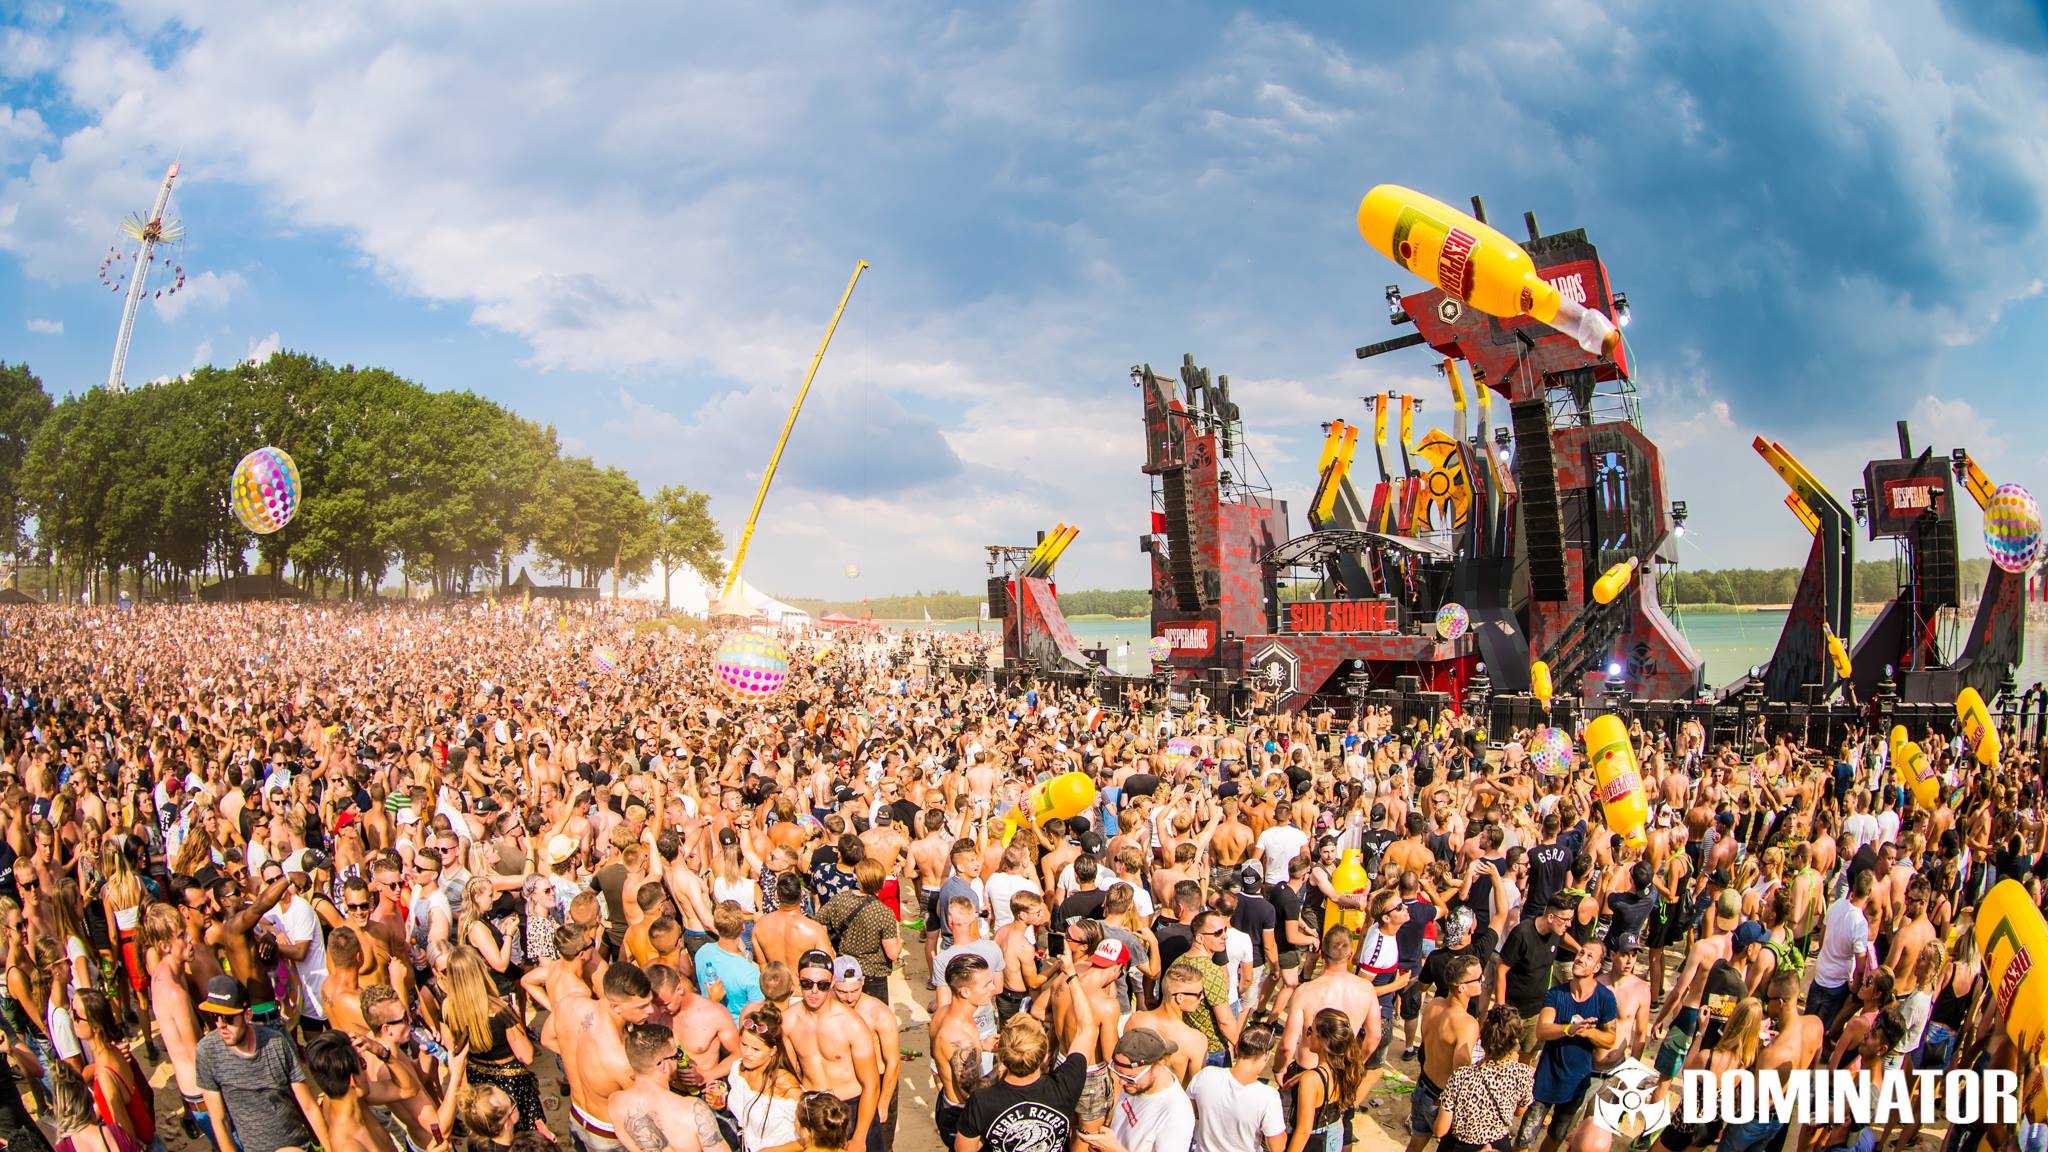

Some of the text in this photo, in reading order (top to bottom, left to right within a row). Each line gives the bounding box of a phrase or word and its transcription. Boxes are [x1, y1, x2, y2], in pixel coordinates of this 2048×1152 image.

[1439, 226, 1477, 300] DESPERA
[1290, 601, 1388, 632] SUB SONIK
[1538, 847, 1565, 863] GSRD
[991, 1106, 1065, 1138] REBEL RCKRS
